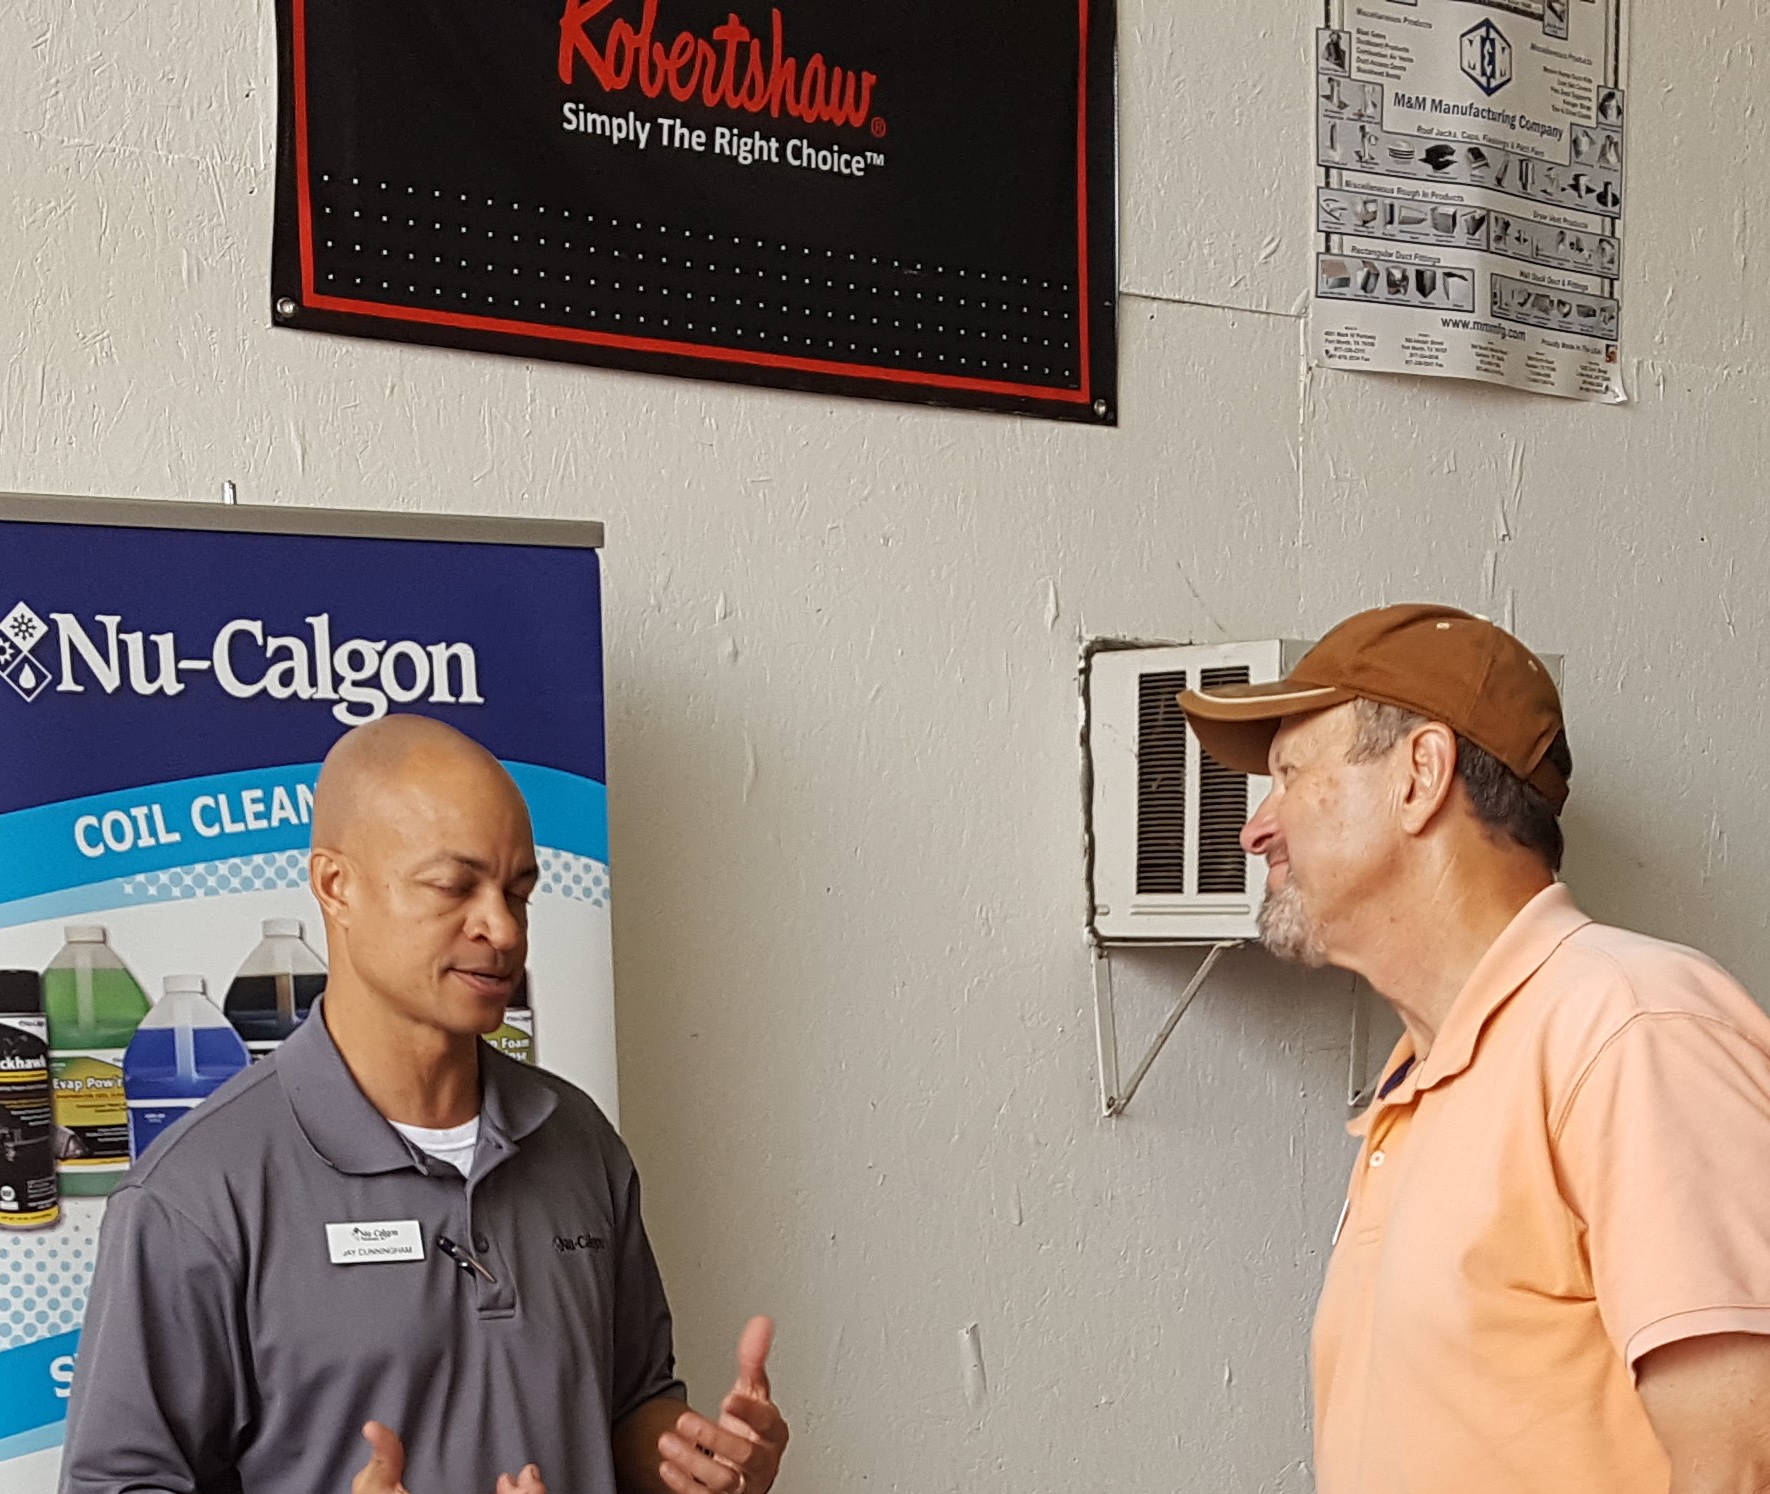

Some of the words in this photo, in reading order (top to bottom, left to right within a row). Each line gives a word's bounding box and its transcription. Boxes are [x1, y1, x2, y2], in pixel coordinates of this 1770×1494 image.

[562, 102, 651, 149] Simply
[657, 117, 706, 151] The
[714, 126, 779, 165] Right
[1394, 92, 1426, 111] M&M
[1430, 98, 1516, 130] Manufacturing
[1519, 115, 1563, 142] Company
[50, 612, 485, 726] Nu-Calgon
[73, 802, 181, 858] COIL
[52, 1078, 82, 1092] Evap
